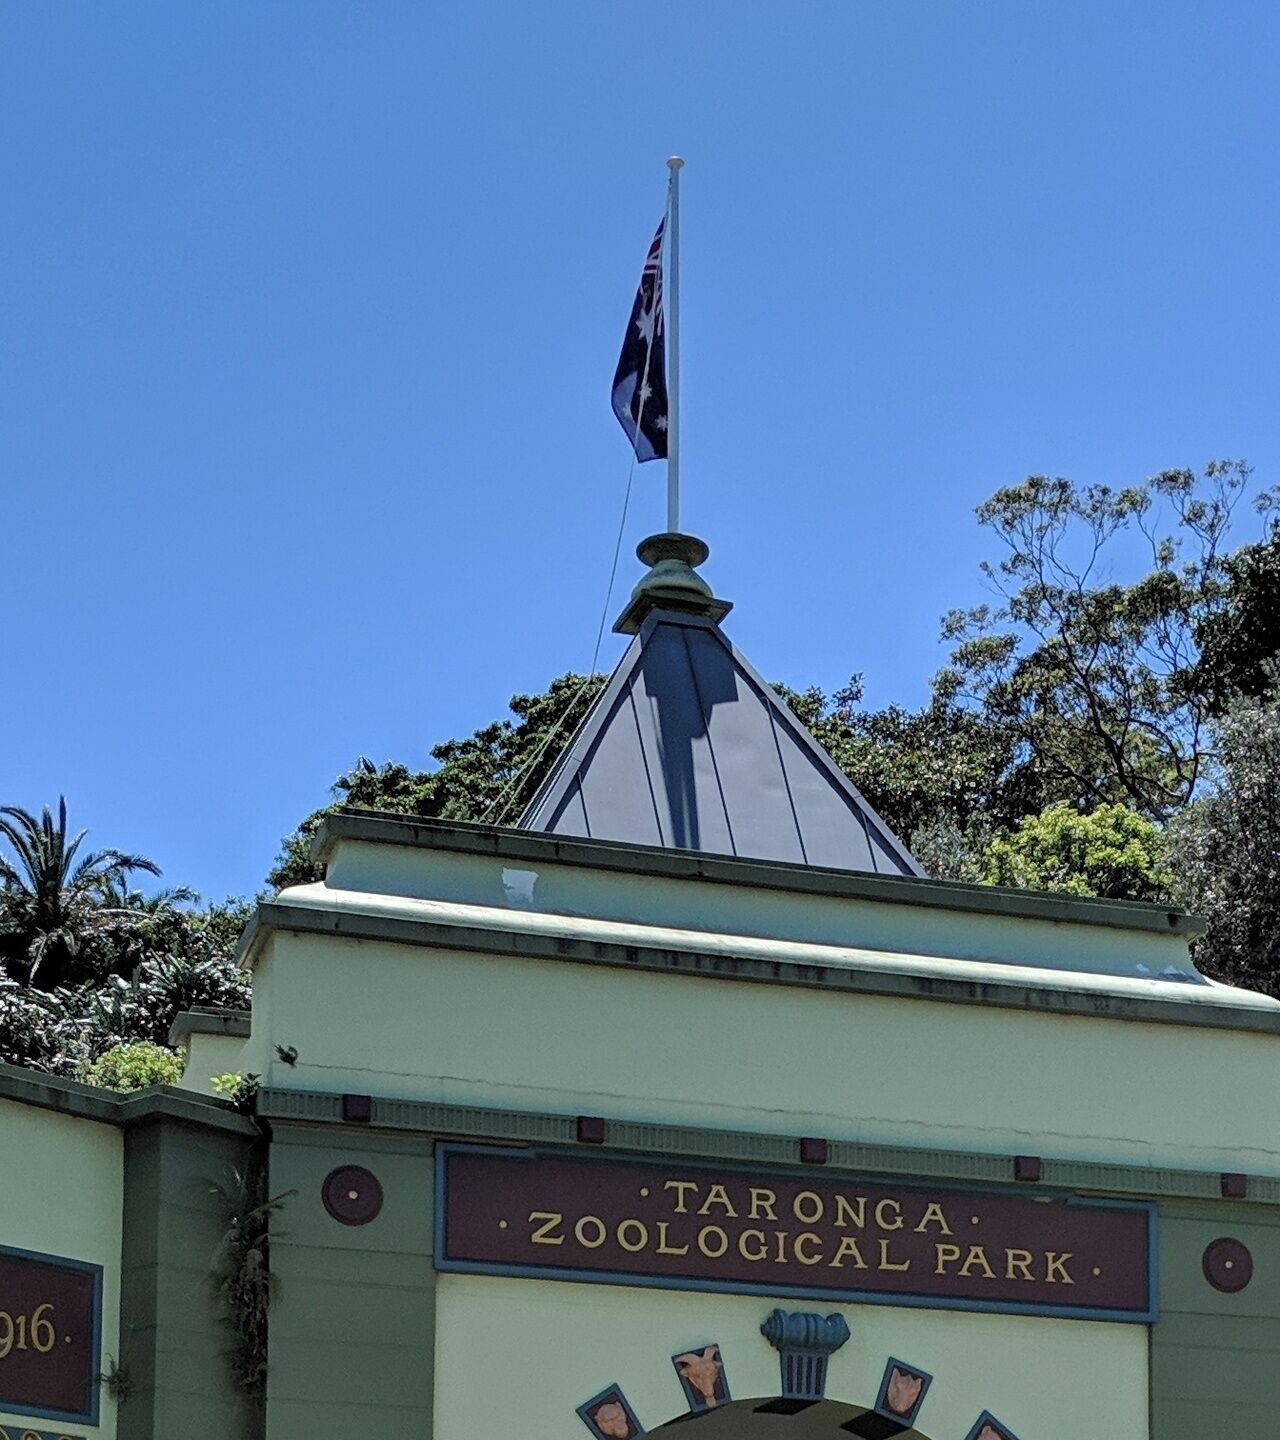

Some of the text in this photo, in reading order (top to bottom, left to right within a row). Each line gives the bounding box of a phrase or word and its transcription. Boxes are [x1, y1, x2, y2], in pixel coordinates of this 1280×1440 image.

[663, 1180, 953, 1235] TARONGA
[528, 1211, 1075, 1284] ZOOLOGICAL PARK
